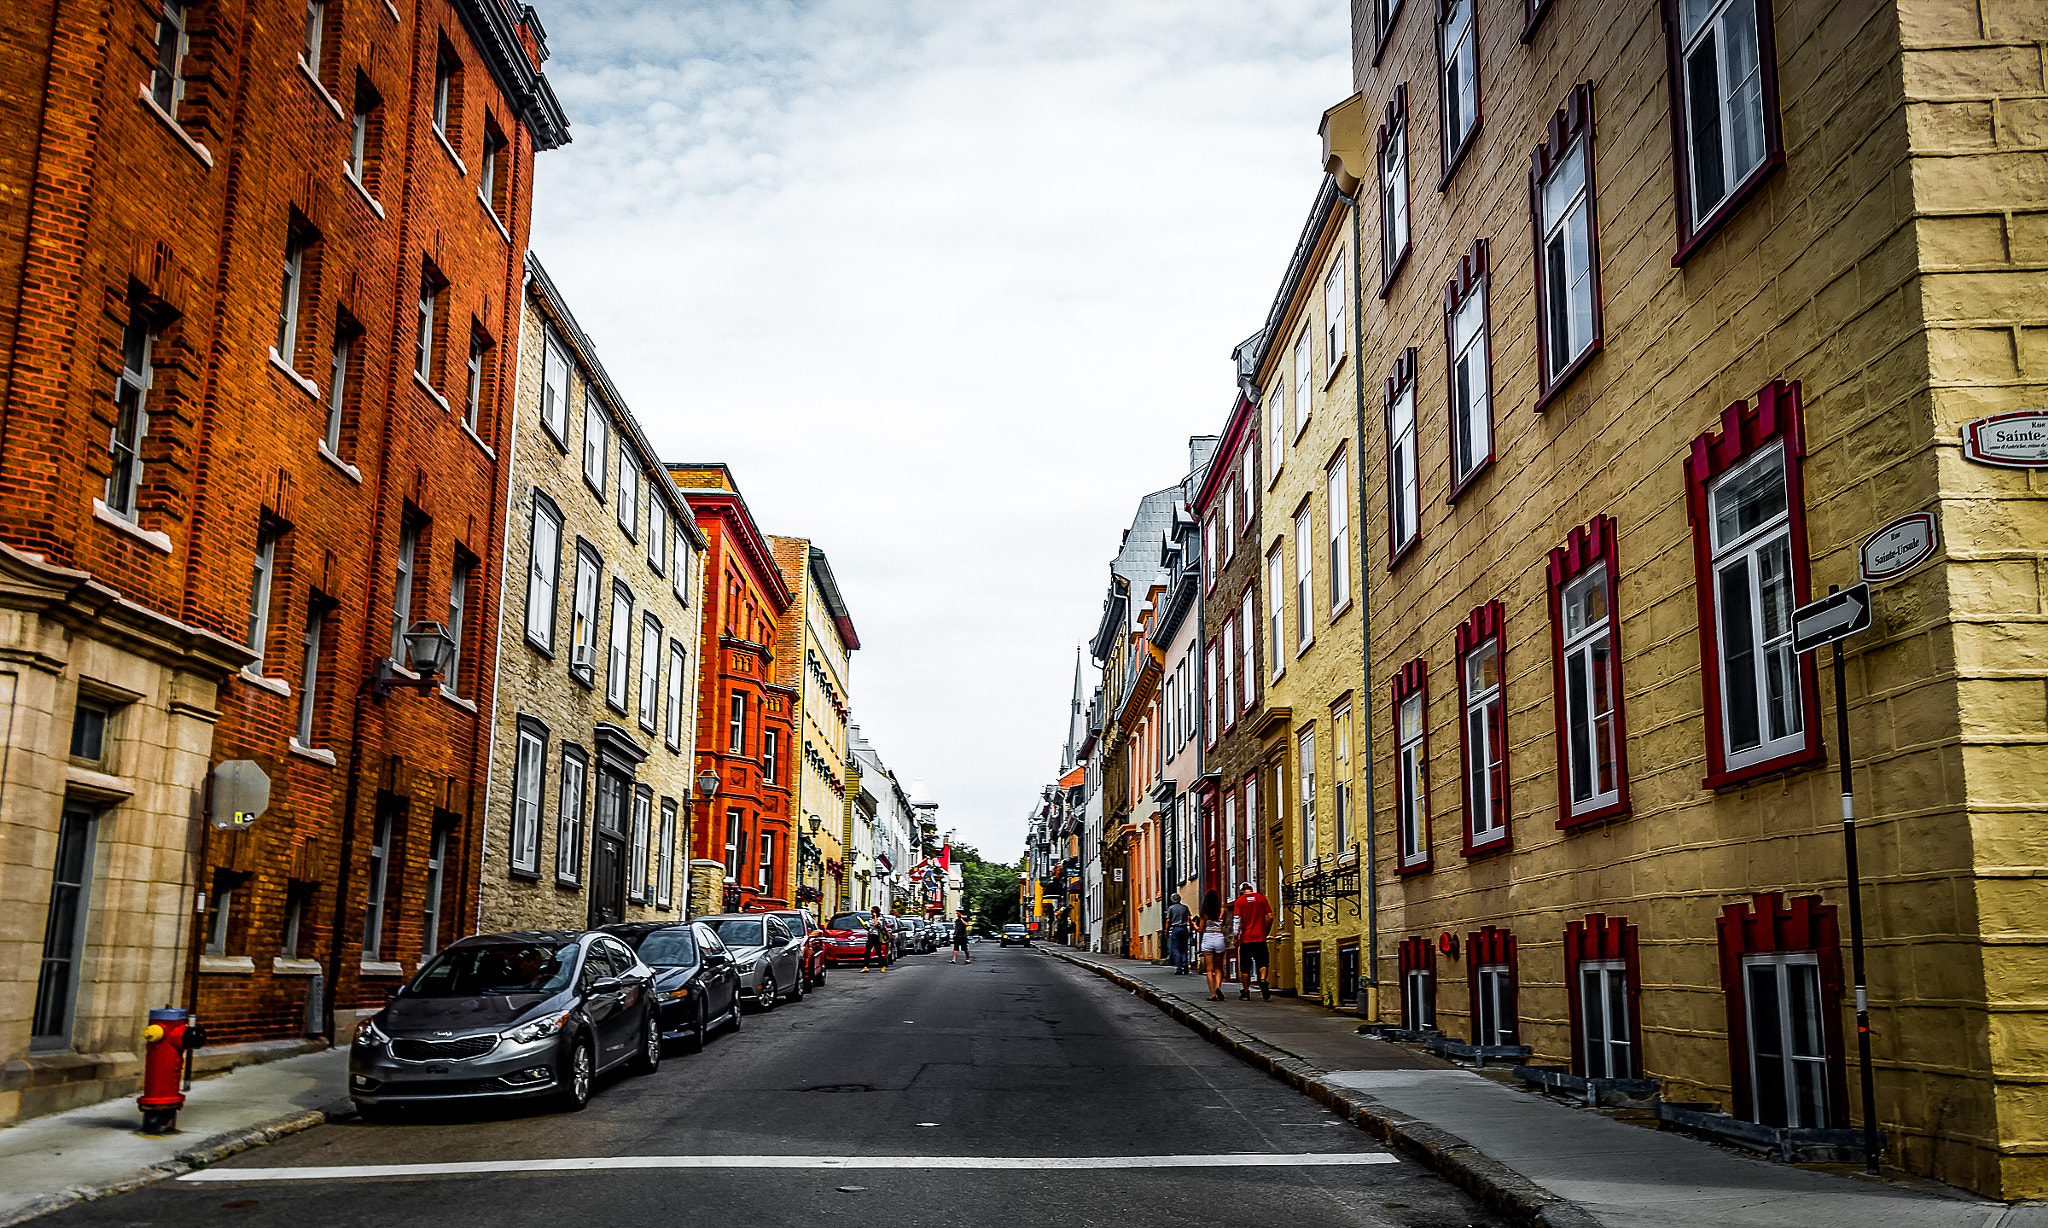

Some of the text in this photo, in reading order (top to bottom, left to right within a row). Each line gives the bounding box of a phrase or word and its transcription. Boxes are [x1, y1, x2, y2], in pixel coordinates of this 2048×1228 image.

[2031, 421, 2046, 429] Rue
[1997, 430, 2048, 442] Sainte-
[1874, 537, 1920, 566] Sainte-Ursule
